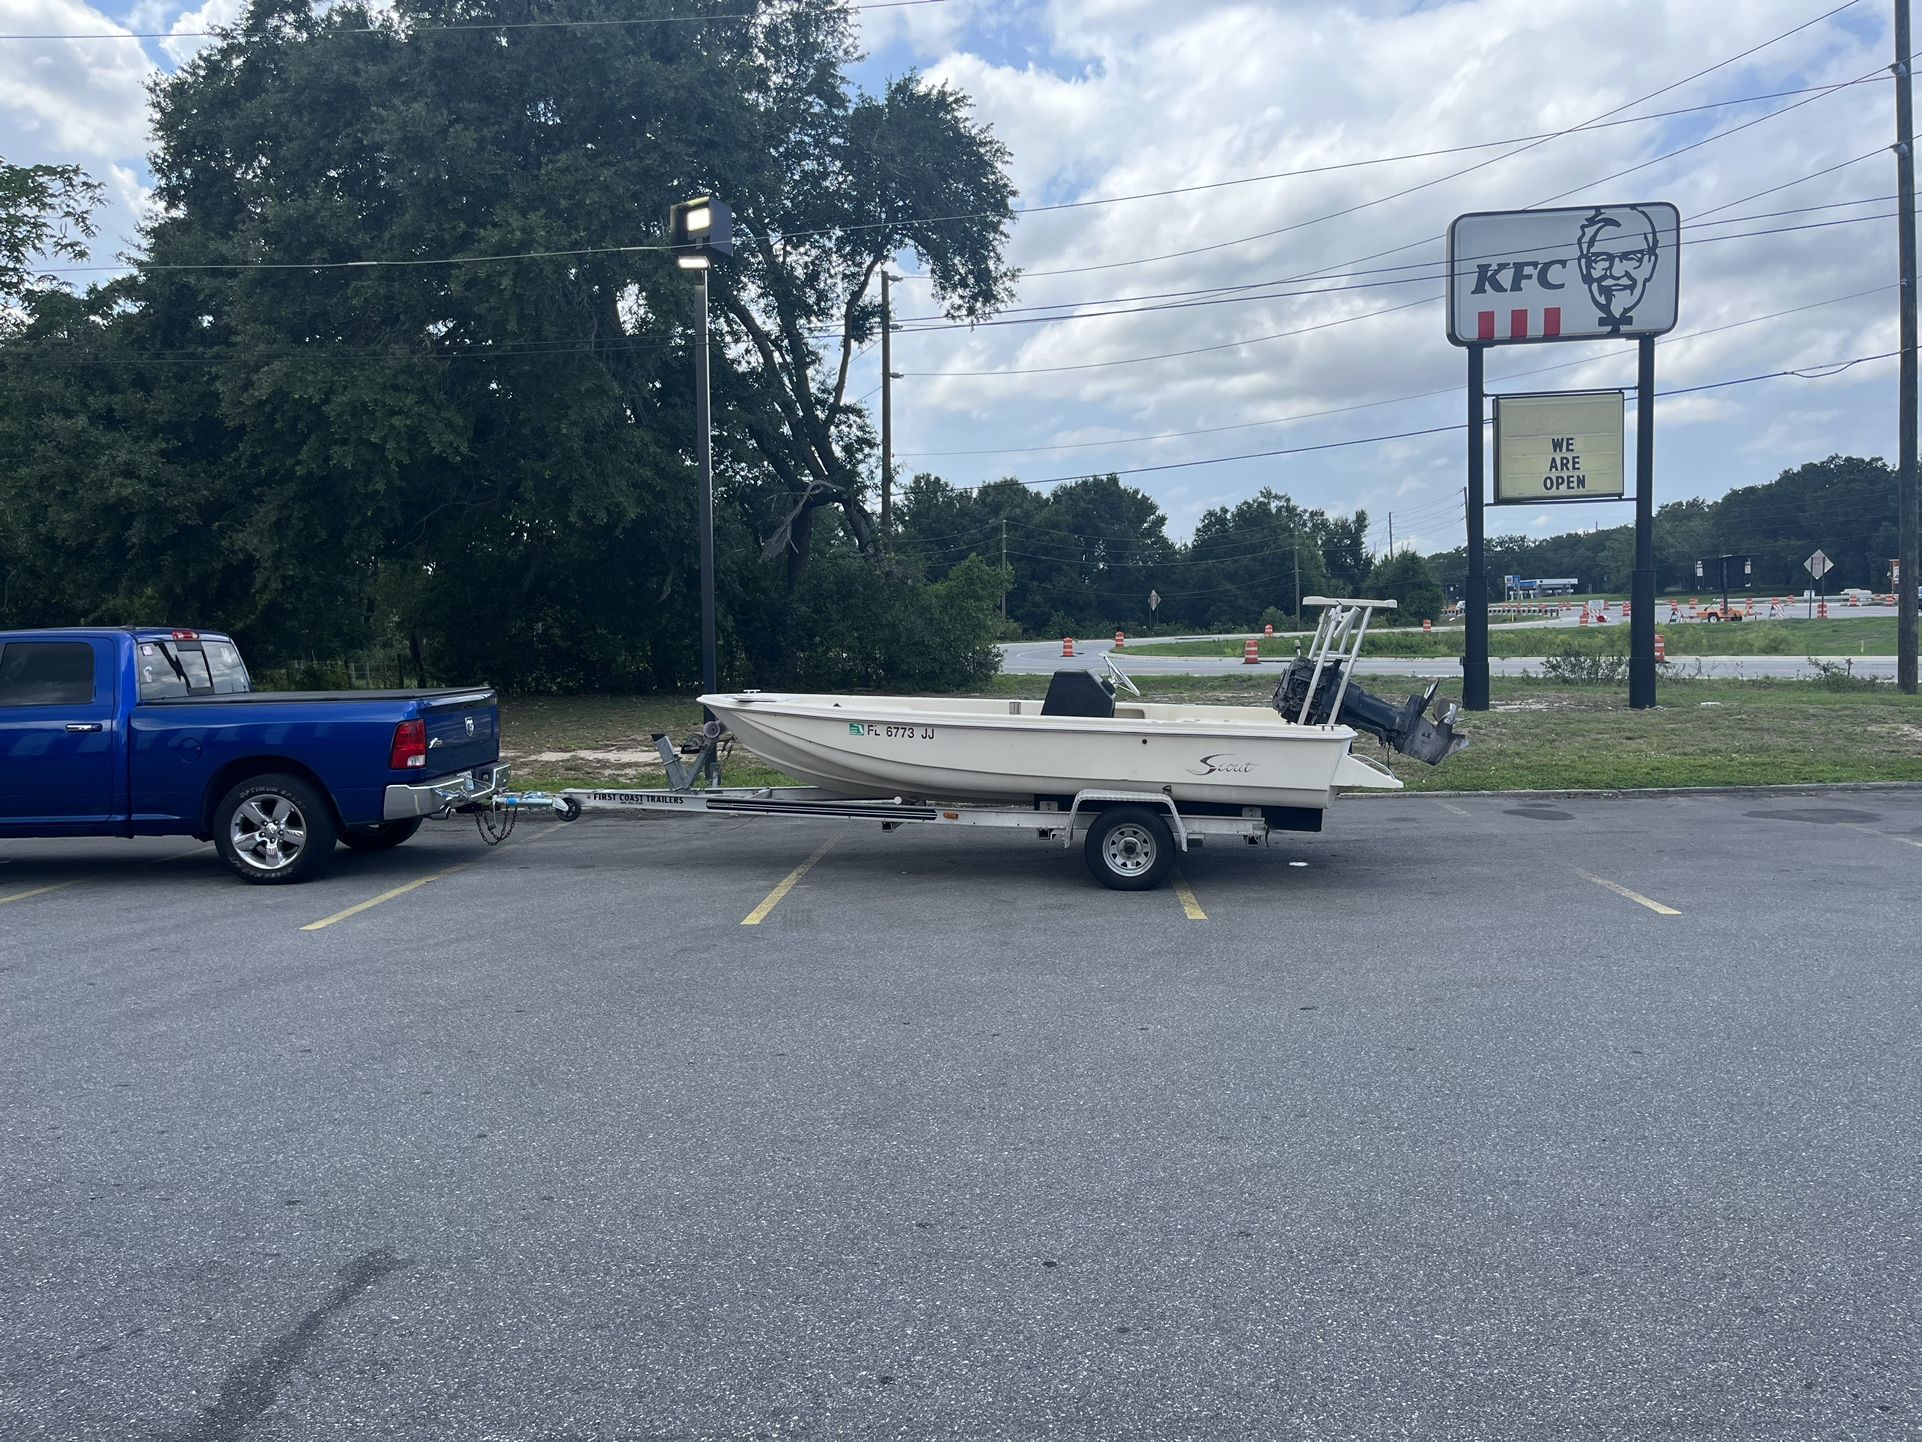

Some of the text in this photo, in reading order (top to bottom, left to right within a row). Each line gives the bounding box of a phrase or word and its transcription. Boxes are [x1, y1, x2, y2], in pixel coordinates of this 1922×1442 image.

[1470, 259, 1567, 294] KFC
[1551, 437, 1574, 453] WE
[1548, 455, 1580, 472] ARE
[1542, 474, 1586, 491] OPEN
[867, 724, 881, 737] FL
[886, 726, 915, 739] 6773
[921, 728, 935, 740] JJ
[1185, 753, 1259, 776] Scout
[593, 793, 616, 801] FIRST
[620, 793, 643, 803] COAST
[646, 795, 684, 805] TRAILERS
